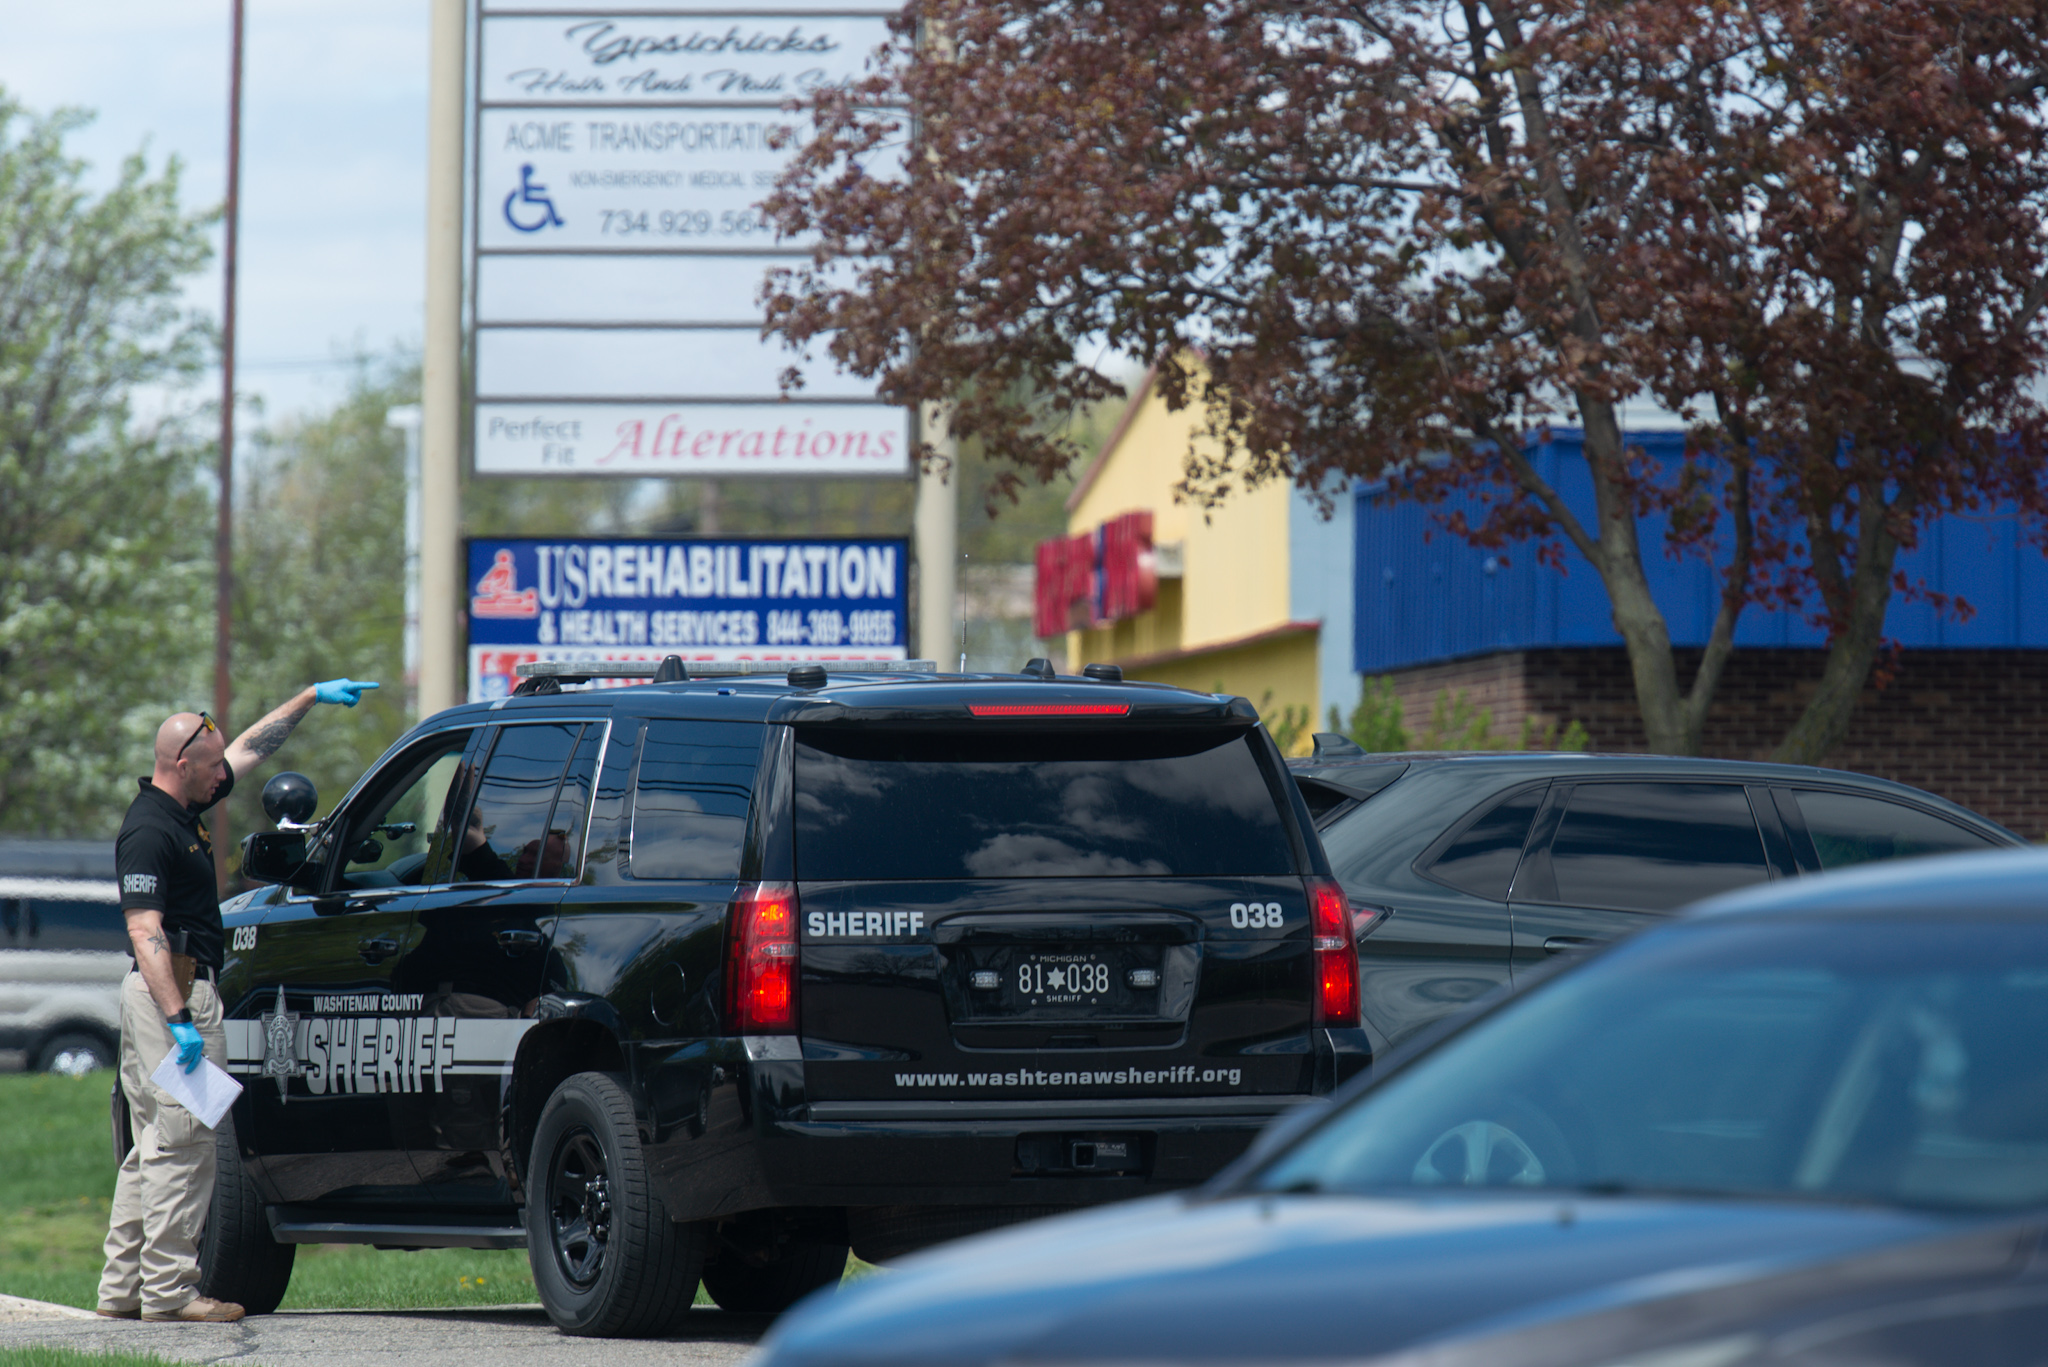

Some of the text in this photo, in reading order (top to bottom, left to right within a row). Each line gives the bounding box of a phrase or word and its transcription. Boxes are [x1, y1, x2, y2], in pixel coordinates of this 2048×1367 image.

[565, 20, 840, 65] Ypsichicks
[507, 68, 604, 94] Hair
[618, 68, 692, 92] And
[702, 68, 786, 93] Nail
[504, 122, 573, 152] ACME
[569, 171, 683, 188] NON-EMERGENCY
[688, 171, 746, 187] MEDICAL
[488, 416, 582, 439] Perfect
[596, 413, 898, 465] Alterations
[542, 446, 576, 466] Fit
[538, 612, 556, 644] &
[560, 611, 647, 645] HEALTH
[650, 611, 758, 645] SERVICES
[123, 873, 157, 894] SHERIFF
[808, 911, 924, 937] SHERIFF
[1229, 902, 1284, 929] 038
[232, 926, 257, 951] 038
[1039, 955, 1087, 963] MICHIGAN
[313, 994, 424, 1012] WASHTENAW COUNTY
[1046, 995, 1082, 1003] SHERIFF
[305, 1017, 456, 1095] SHERIFF
[894, 1066, 1242, 1087] www.washtenawsheriff.org
